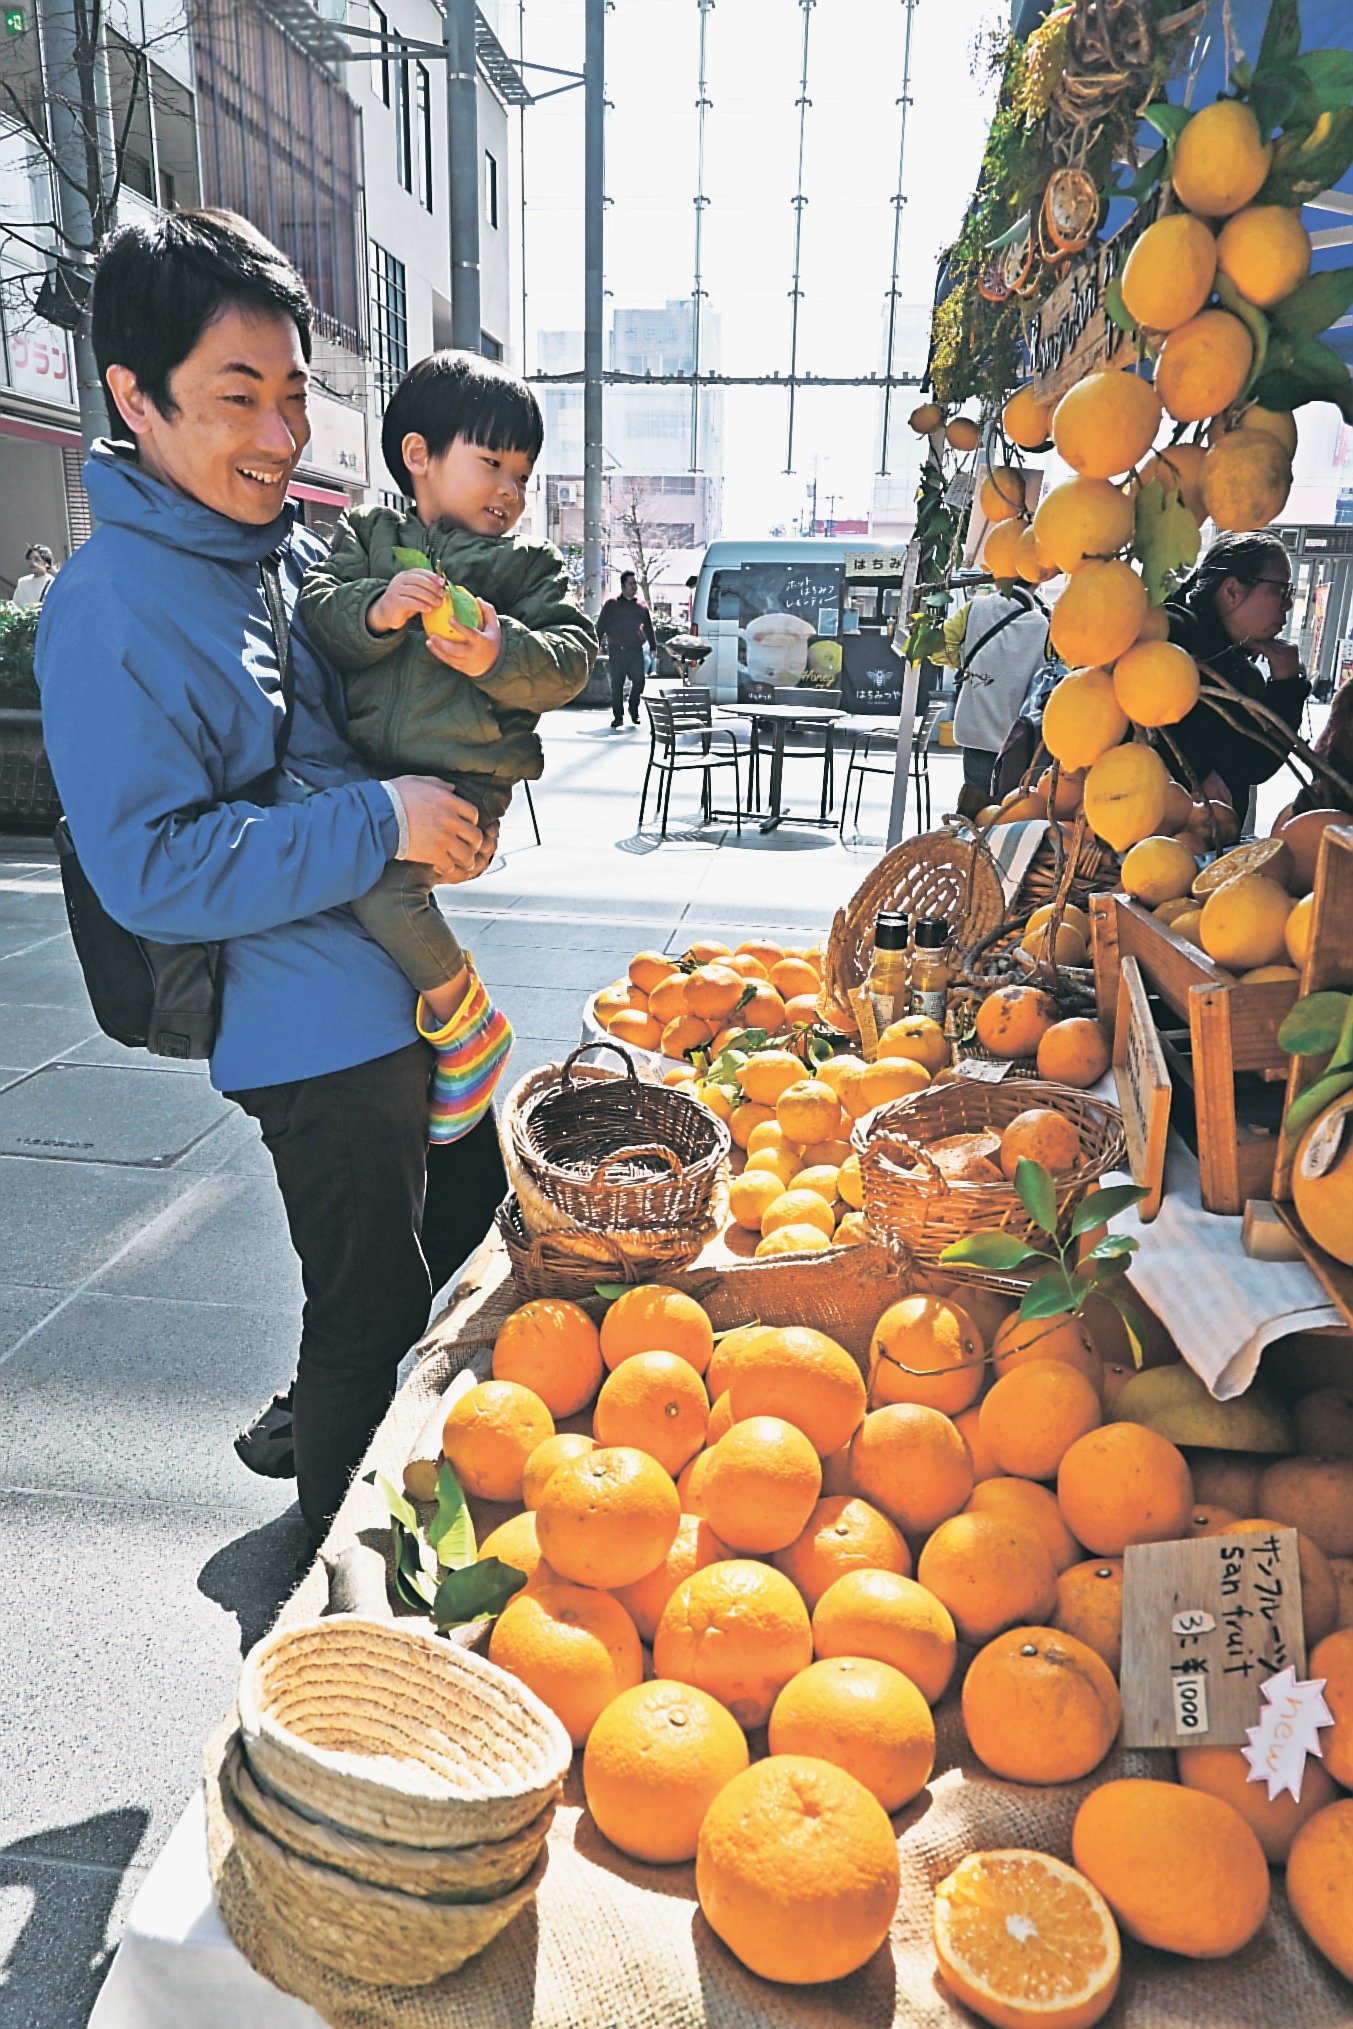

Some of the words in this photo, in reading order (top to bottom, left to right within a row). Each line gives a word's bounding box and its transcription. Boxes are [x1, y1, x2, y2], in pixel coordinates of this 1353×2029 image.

[856, 690, 901, 700] はちみつや
[1222, 1604, 1253, 1677] fruit
[1252, 1535, 1287, 1674] サンフルーツ
[1264, 1697, 1304, 1773] new
